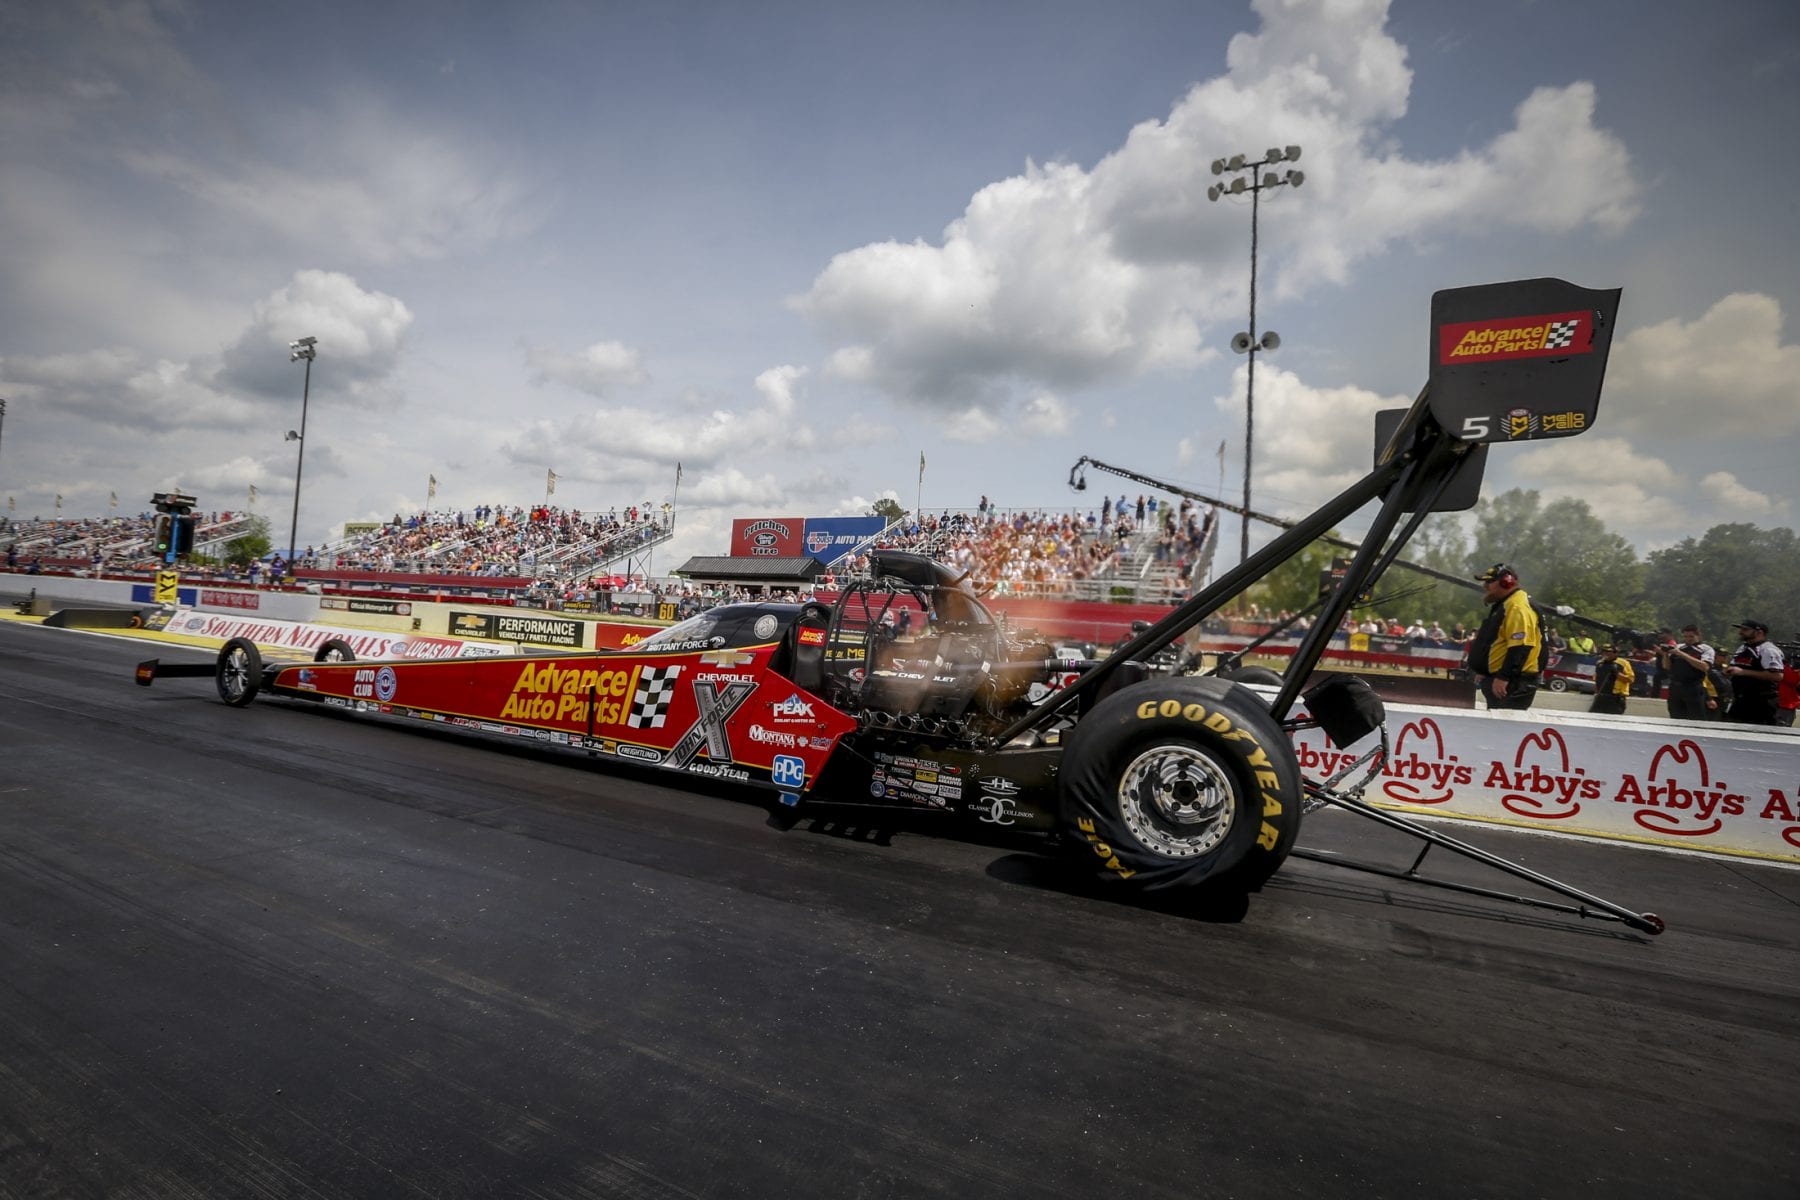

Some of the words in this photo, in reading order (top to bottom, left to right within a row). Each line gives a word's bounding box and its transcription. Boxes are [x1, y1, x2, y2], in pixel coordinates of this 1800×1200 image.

[1460, 326, 1544, 344] Advance
[1449, 343, 1493, 357] Auto
[1492, 339, 1540, 353] Parts
[1461, 416, 1490, 440] 5
[744, 520, 790, 540] Pritchett
[834, 535, 856, 545] AUTO
[751, 546, 779, 556] Tire
[201, 616, 285, 643] SOUTHERN
[455, 629, 487, 638] CHEVROLET
[499, 618, 576, 636] PERFORMANCE
[499, 631, 526, 640] VEHICLES
[529, 634, 548, 643] PARTS
[552, 636, 574, 645] RACING
[646, 642, 681, 652] BRITTANY
[682, 639, 708, 650] FORCE
[405, 640, 441, 658] LUCAS
[440, 644, 458, 658] OIL
[354, 670, 375, 682] AUTO
[513, 663, 628, 696] Advance
[697, 672, 755, 683] CHEVROLET
[898, 672, 956, 683] CHEVLET
[353, 684, 373, 697] CLUB
[500, 693, 555, 720] Auto
[556, 694, 621, 725] Parts
[773, 703, 816, 717] PEAK
[673, 728, 702, 766] JOHN
[701, 687, 737, 736] FORCE
[749, 724, 795, 746] MONTANA
[620, 746, 658, 760] FREIGHTLINER
[689, 763, 750, 780] GOODYEAR
[774, 759, 803, 782] PPG
[1137, 700, 1282, 851] GOODYEAR
[1483, 761, 1601, 804] Arby's
[1614, 774, 1745, 820] Arby's
[1003, 809, 1034, 818] COLLISION
